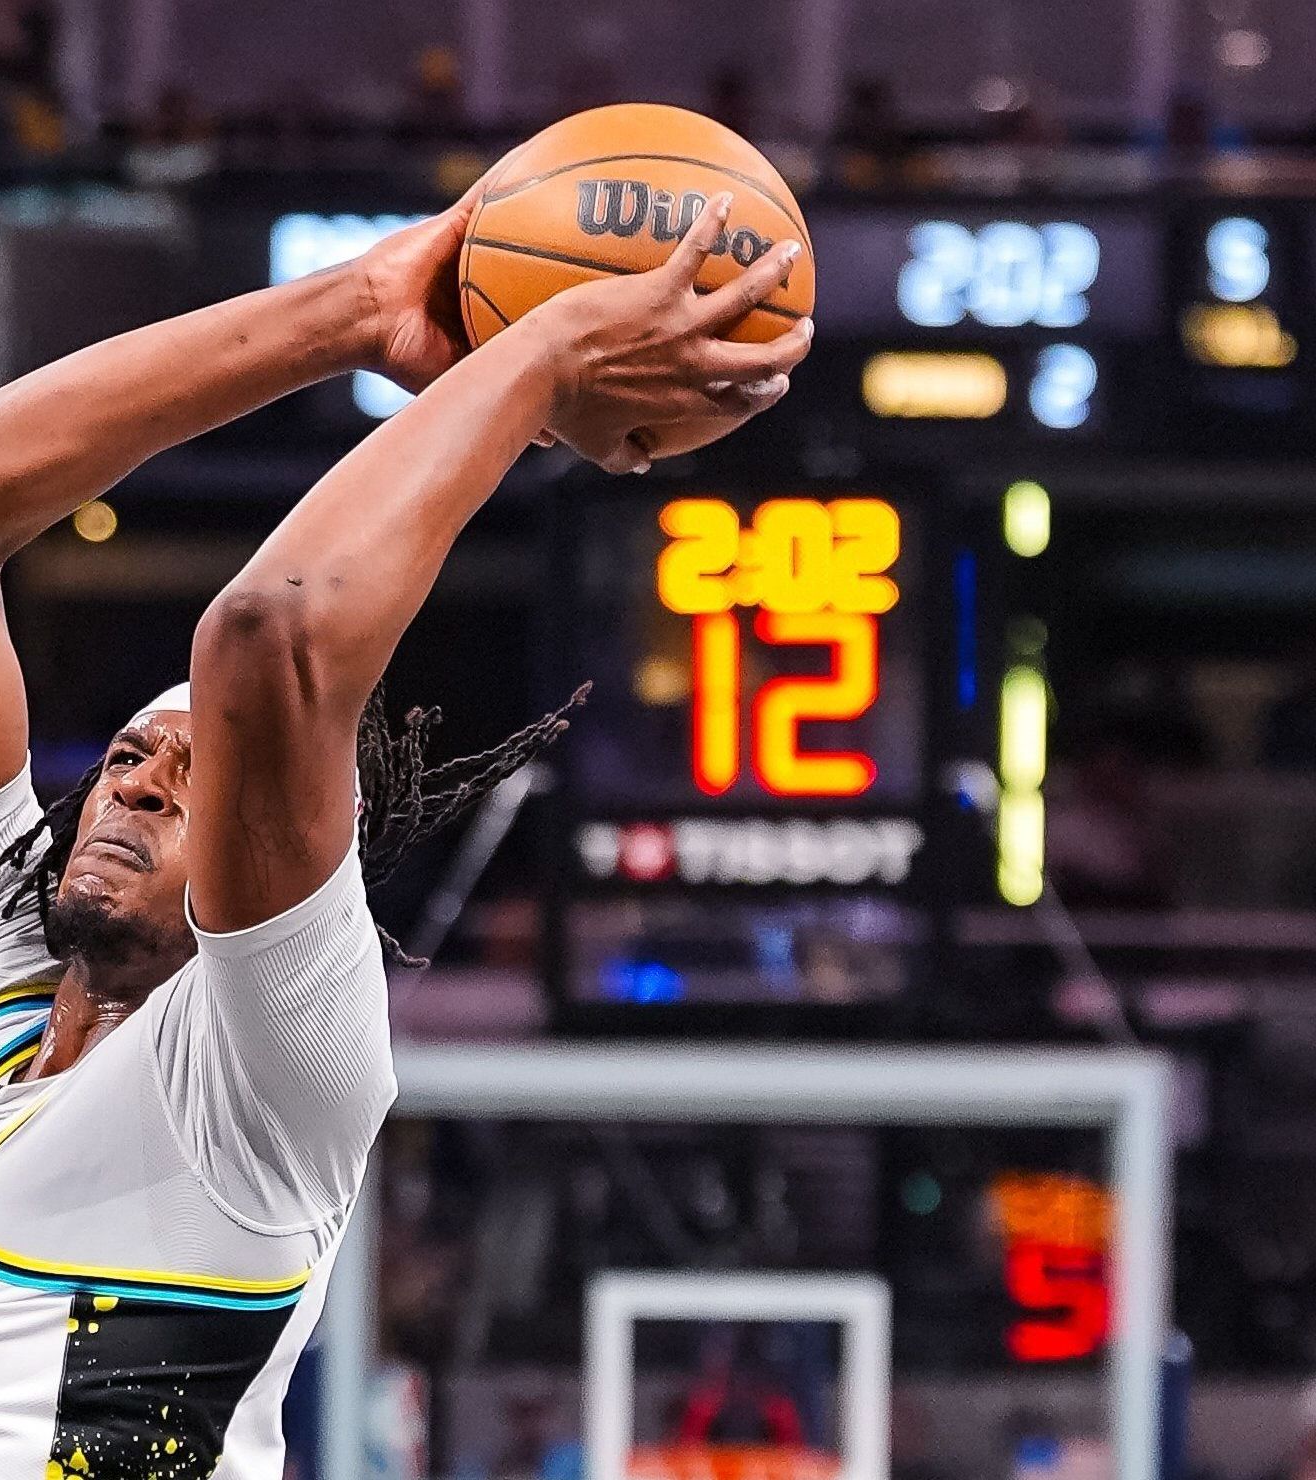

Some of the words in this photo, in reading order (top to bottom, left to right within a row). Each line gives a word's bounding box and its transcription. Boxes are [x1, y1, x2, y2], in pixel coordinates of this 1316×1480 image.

[577, 179, 782, 270] Wilo
[658, 497, 900, 614] 2:02
[692, 610, 880, 797] 12
